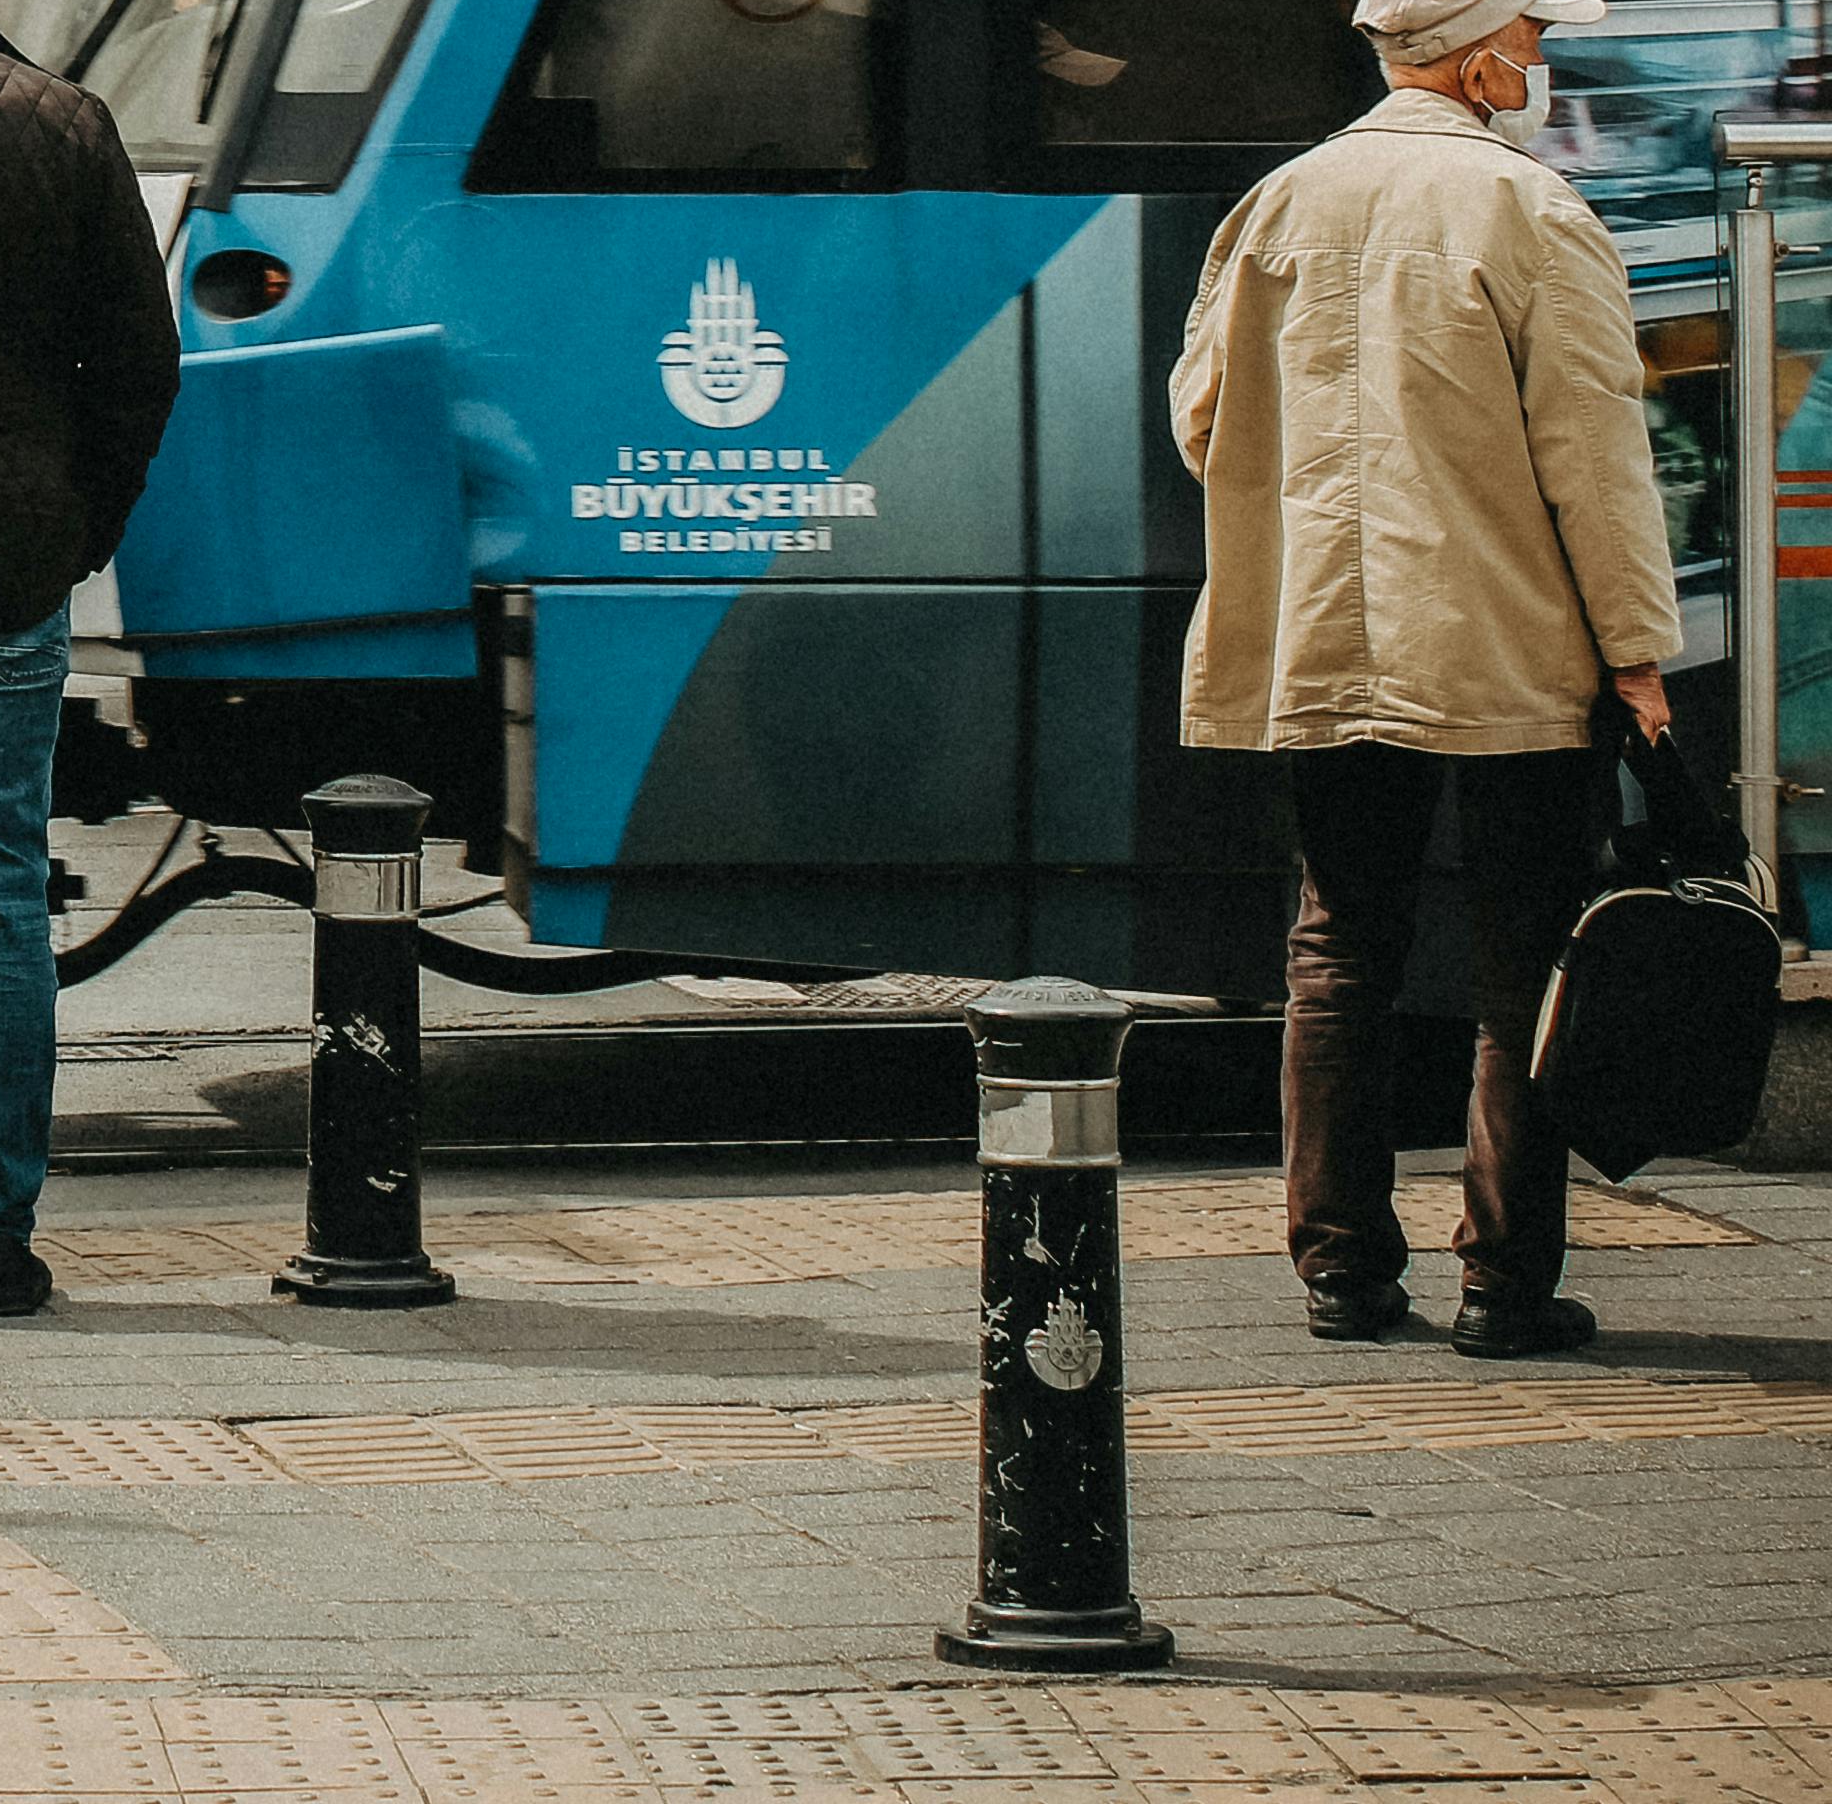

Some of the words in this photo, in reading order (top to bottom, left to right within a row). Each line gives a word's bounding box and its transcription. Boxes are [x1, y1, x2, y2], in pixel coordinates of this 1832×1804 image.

[617, 446, 830, 472] İSTANBUL
[571, 477, 878, 522] BÜYÜKŞEHİR
[619, 526, 832, 552] BELEDİYESİ
